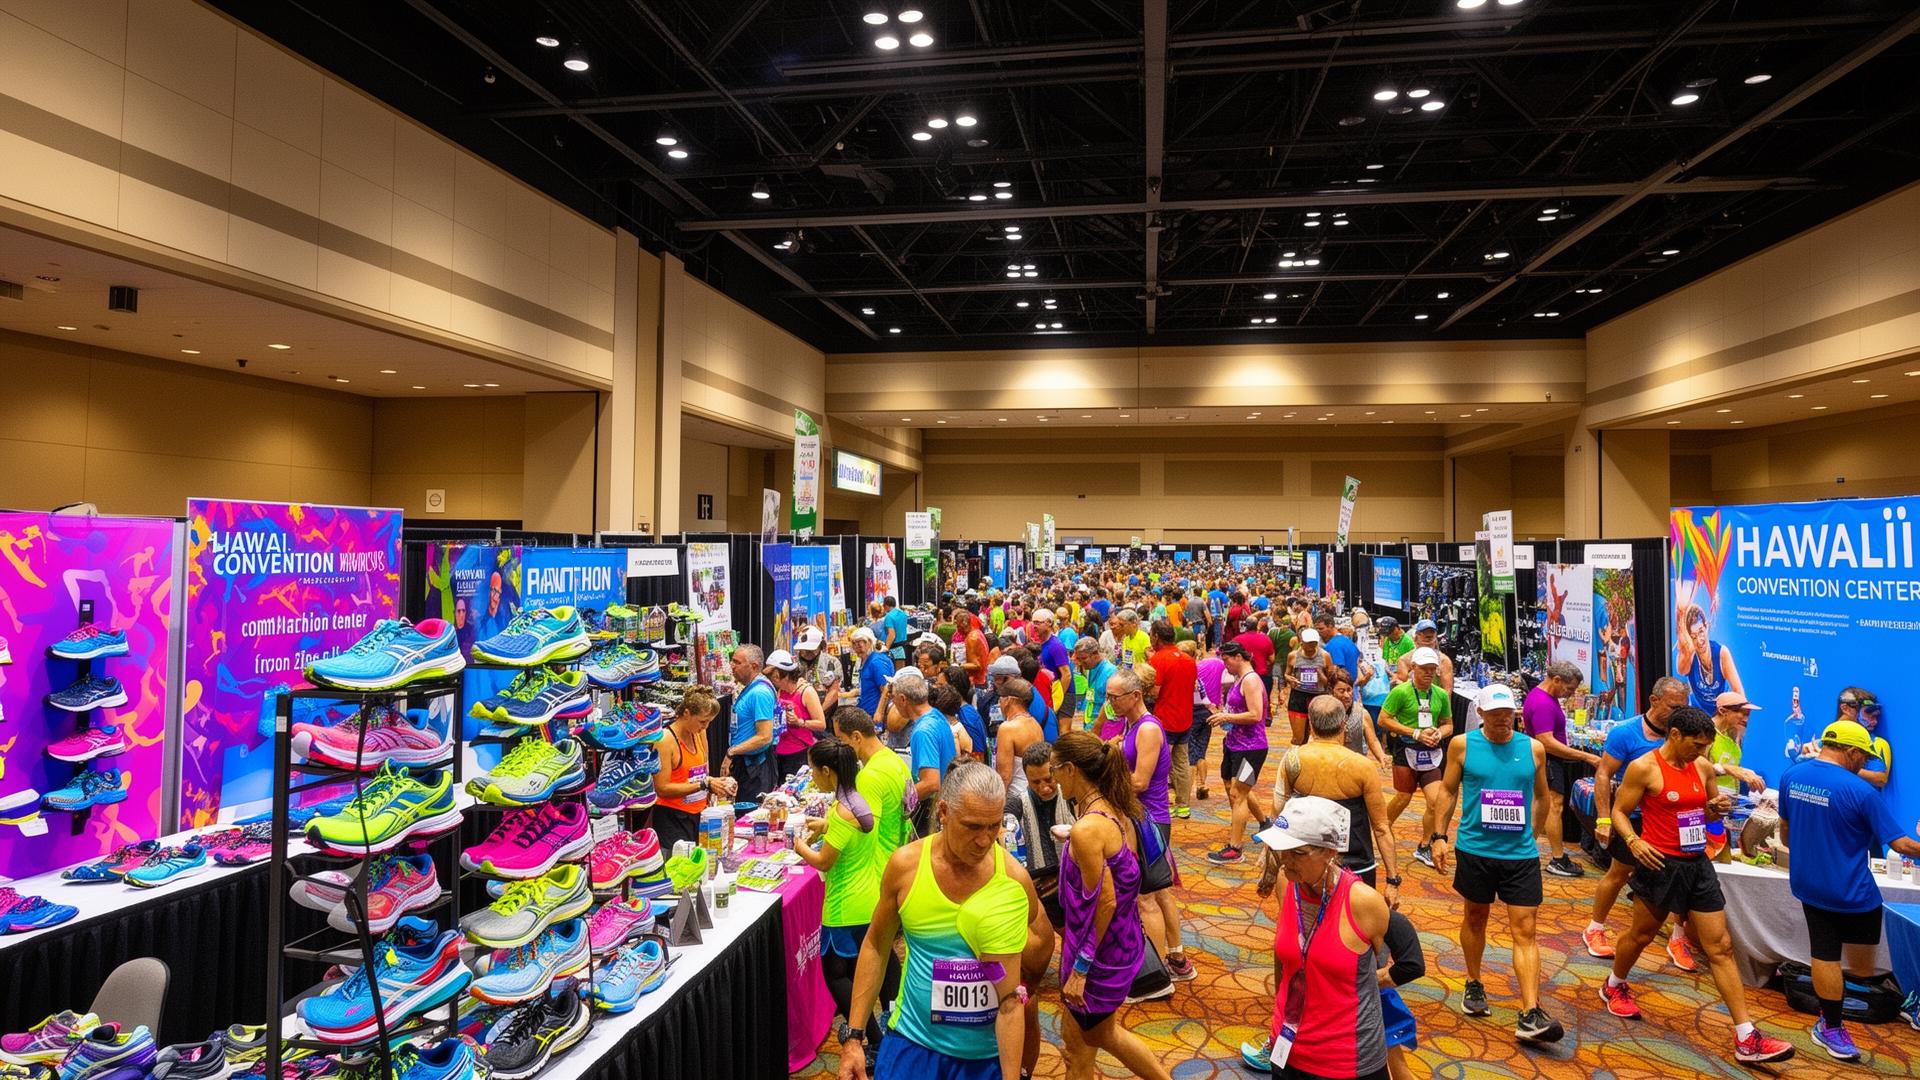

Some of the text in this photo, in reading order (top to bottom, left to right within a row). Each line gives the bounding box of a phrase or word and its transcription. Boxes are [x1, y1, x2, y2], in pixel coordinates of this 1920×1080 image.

[213, 551, 334, 575] CONVENTION
[1737, 576, 1920, 601] CONVENTION CENTER
